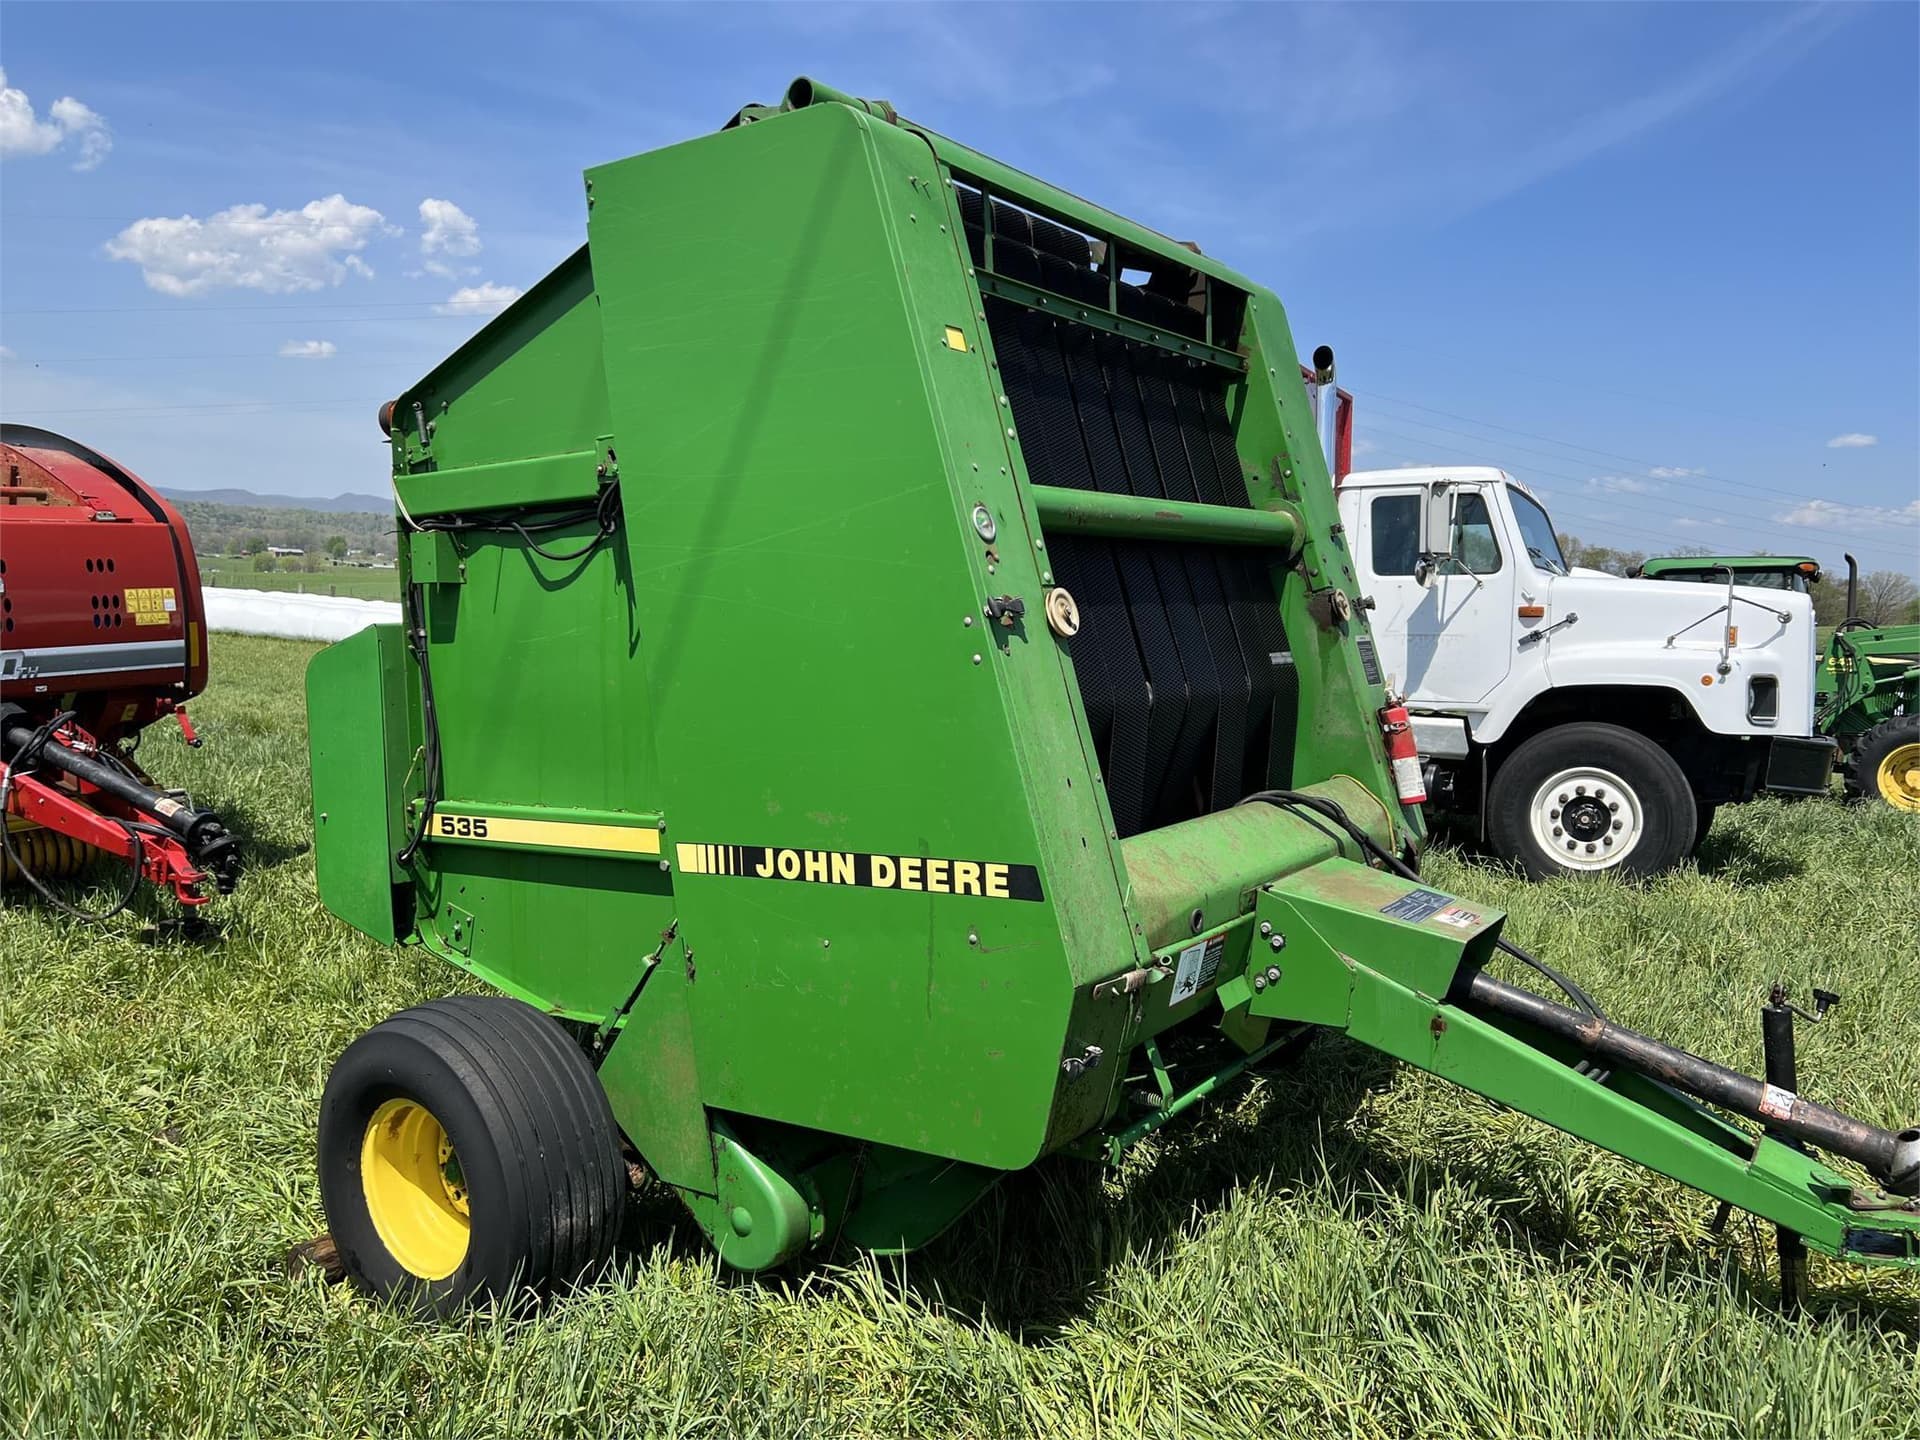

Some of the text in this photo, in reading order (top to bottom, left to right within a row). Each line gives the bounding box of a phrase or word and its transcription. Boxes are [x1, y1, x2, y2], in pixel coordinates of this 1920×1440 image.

[441, 816, 488, 838] 535
[755, 847, 1010, 898] JOHN DEERE
